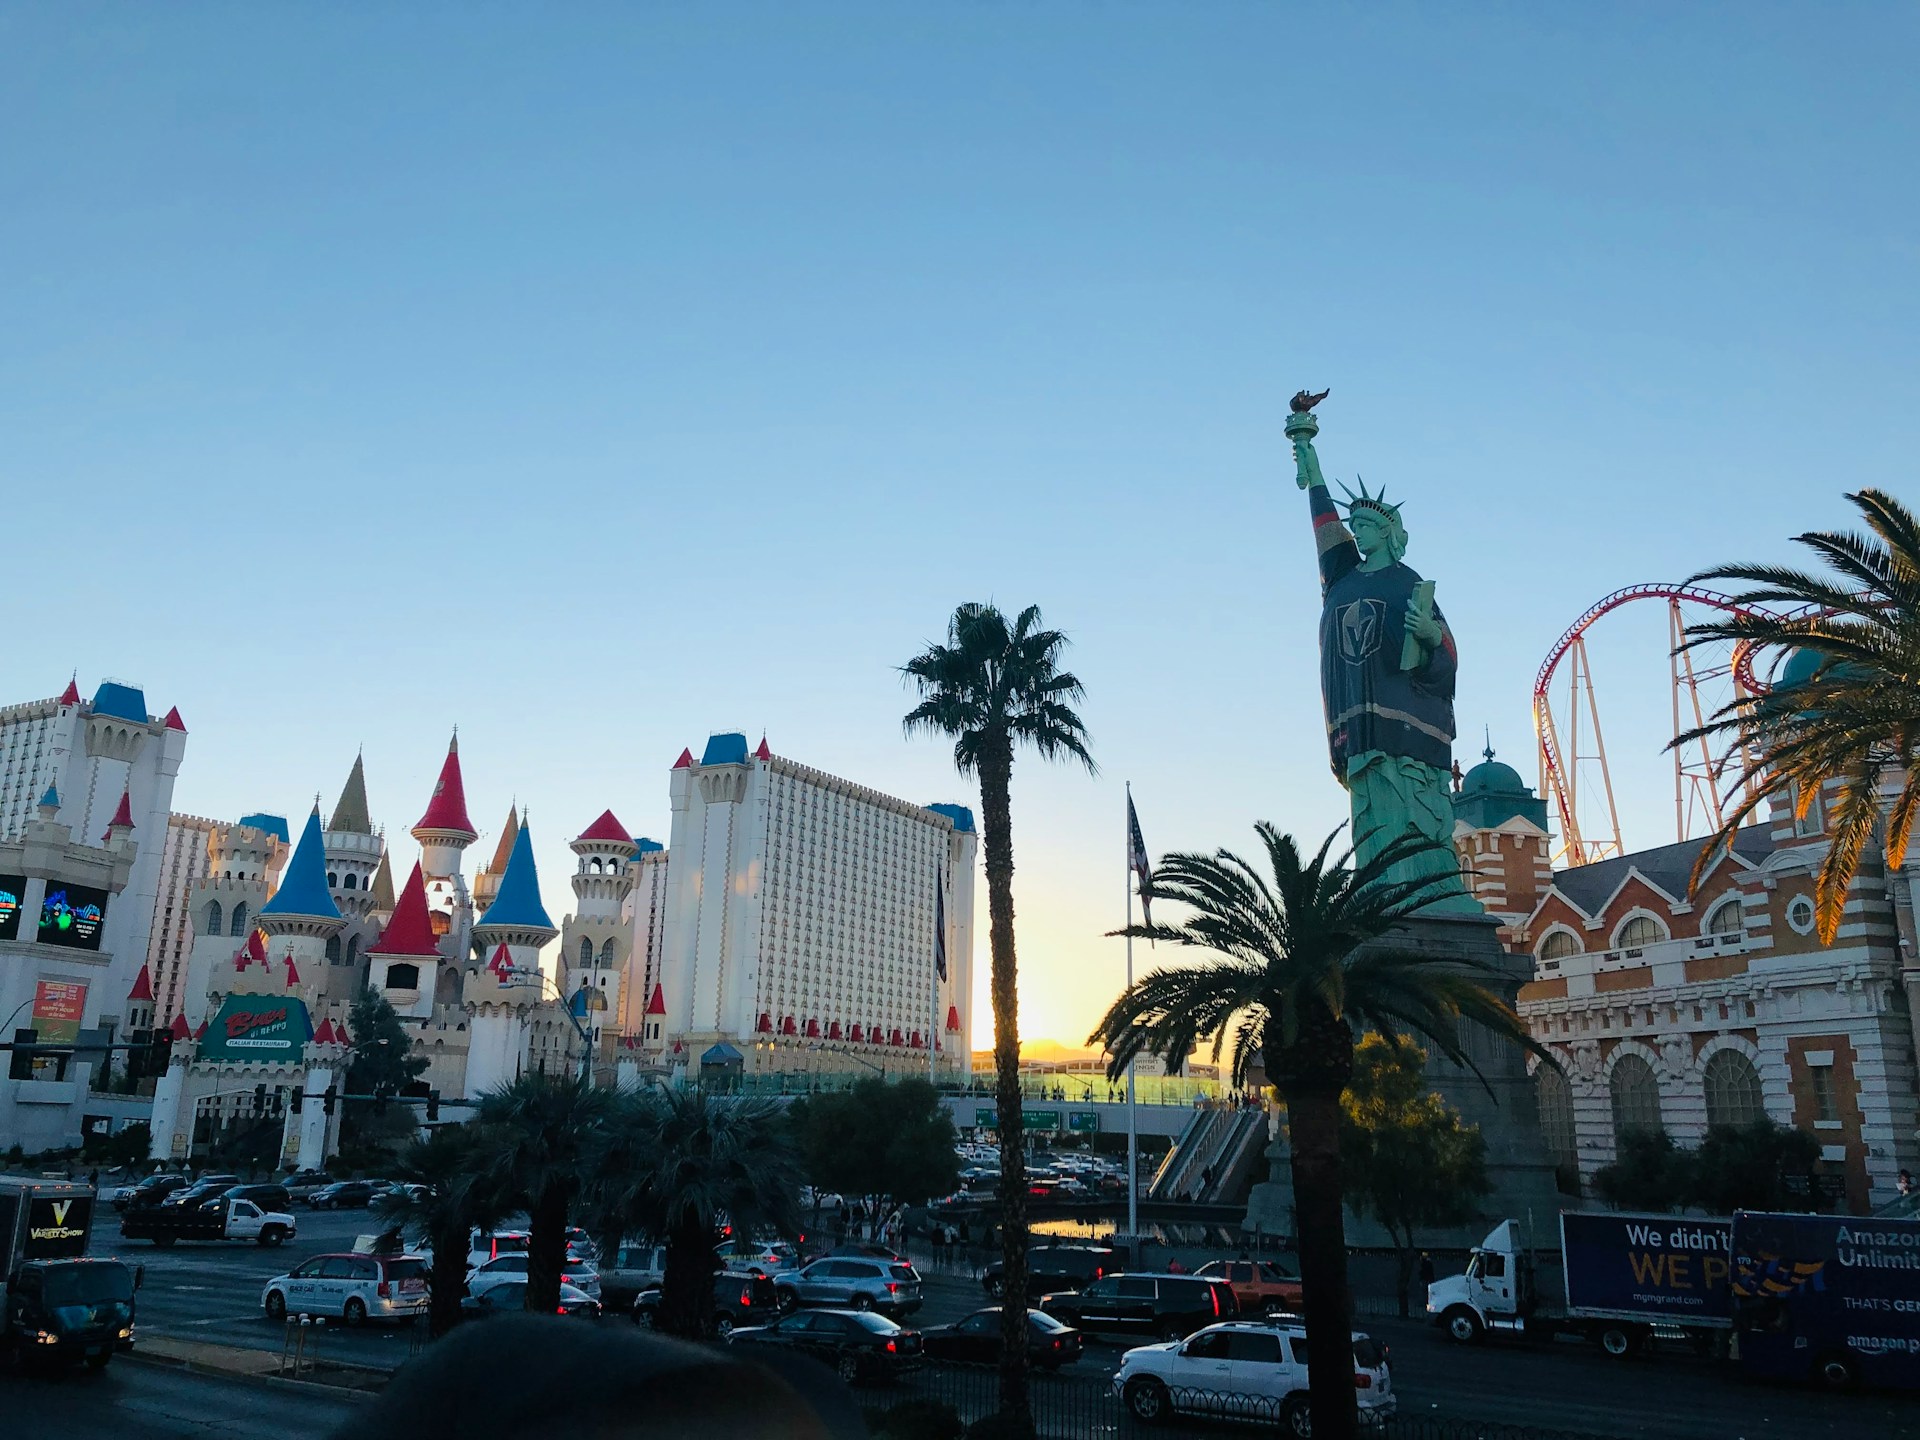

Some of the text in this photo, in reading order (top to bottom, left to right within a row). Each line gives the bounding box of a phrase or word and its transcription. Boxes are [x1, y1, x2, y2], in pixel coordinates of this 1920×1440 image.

[1626, 1224, 1729, 1252] We didn't
[1628, 1252, 1729, 1291] WE P
[1633, 1293, 1704, 1305] mgmgrand.com
[1843, 1297, 1892, 1311] THAT'S
[1847, 1336, 1906, 1350] amazon
